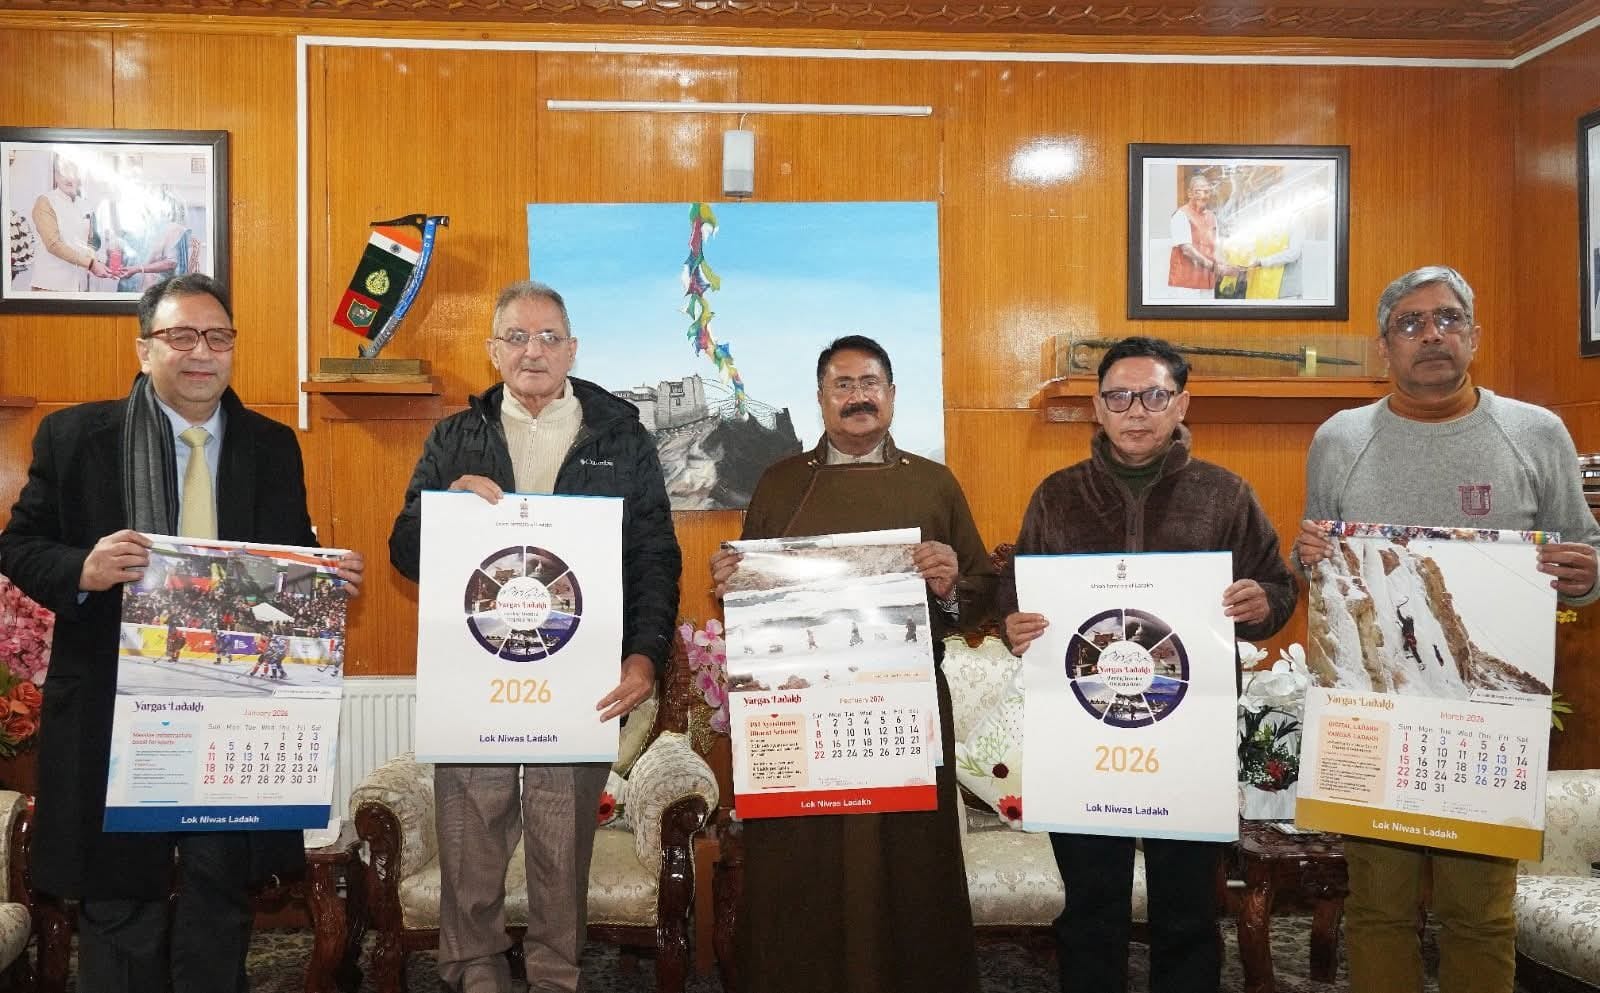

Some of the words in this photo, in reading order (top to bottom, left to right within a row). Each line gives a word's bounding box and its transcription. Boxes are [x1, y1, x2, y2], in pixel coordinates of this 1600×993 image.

[490, 679, 552, 704] 2026
[134, 702, 167, 712] Yargas
[169, 702, 204, 712] Ladakh
[744, 697, 770, 708] Yargas
[772, 695, 801, 704] Ladakh
[1327, 694, 1357, 706] Yargas
[1358, 696, 1394, 710] Ladakh
[912, 715, 916, 723] 7
[1440, 712, 1464, 721] March
[1466, 714, 1484, 723] 2026
[281, 732, 285, 740] 1
[298, 732, 303, 740] 2
[313, 732, 318, 740] 3
[816, 730, 821, 738] 8
[1419, 725, 1433, 733] Mon
[1457, 729, 1472, 737] Wed
[480, 734, 496, 743] Lok
[498, 734, 524, 743] Niwas
[527, 734, 558, 743] Ladakh
[1404, 733, 1408, 741] 1
[1422, 734, 1427, 743] 2
[1440, 736, 1445, 745] 3
[1460, 738, 1466, 747] 4
[1481, 741, 1487, 750] 5
[1500, 743, 1505, 751] 6
[1520, 745, 1526, 753] 7
[229, 742, 234, 750] 5
[208, 753, 215, 761] 11
[226, 753, 235, 761] 12
[244, 753, 252, 761] 13
[260, 753, 270, 761] 14
[277, 753, 286, 761] 15
[295, 753, 303, 761] 16
[310, 753, 318, 761] 17
[832, 750, 842, 758] 23
[863, 749, 873, 757] 25
[1095, 745, 1160, 773] 2026
[1402, 744, 1408, 752] 8
[1421, 746, 1426, 754] 9
[1438, 748, 1447, 757] 10
[1459, 750, 1466, 759] 11
[1478, 753, 1488, 761] 12
[1497, 755, 1506, 764] 13
[1517, 757, 1527, 766] 14
[206, 764, 215, 772] 18
[225, 764, 234, 772] 19
[241, 764, 253, 772] 20
[260, 764, 268, 772] 21
[275, 764, 286, 772] 22
[292, 764, 303, 772] 23
[308, 764, 318, 772] 24
[1400, 755, 1409, 765] 15
[1418, 758, 1428, 766] 16
[1438, 760, 1446, 769] 17
[1456, 762, 1466, 771] 18
[1477, 764, 1487, 773] 19
[1494, 767, 1507, 776] 20
[1516, 769, 1526, 778] 21
[204, 776, 215, 784] 25
[223, 776, 234, 784] 26
[241, 776, 251, 784] 27
[258, 776, 269, 784] 28
[274, 776, 285, 784] 29
[291, 776, 302, 784] 30
[307, 776, 317, 784] 31
[1398, 767, 1409, 776] 22
[1416, 769, 1428, 778] 23
[1434, 771, 1446, 780] 24
[1455, 774, 1467, 783] 25
[1475, 776, 1487, 785] 26
[1494, 778, 1506, 788] 27
[1514, 781, 1527, 790] 28
[1396, 779, 1408, 788] 29
[1415, 781, 1426, 790] 30
[1435, 784, 1445, 792] 31
[1086, 803, 1102, 813] Lok
[1105, 804, 1133, 815] Niwas
[1136, 806, 1169, 816] Ladakh
[1373, 820, 1389, 830] Lok
[1392, 823, 1420, 835] Niwas
[1423, 827, 1458, 840] Ladakh
